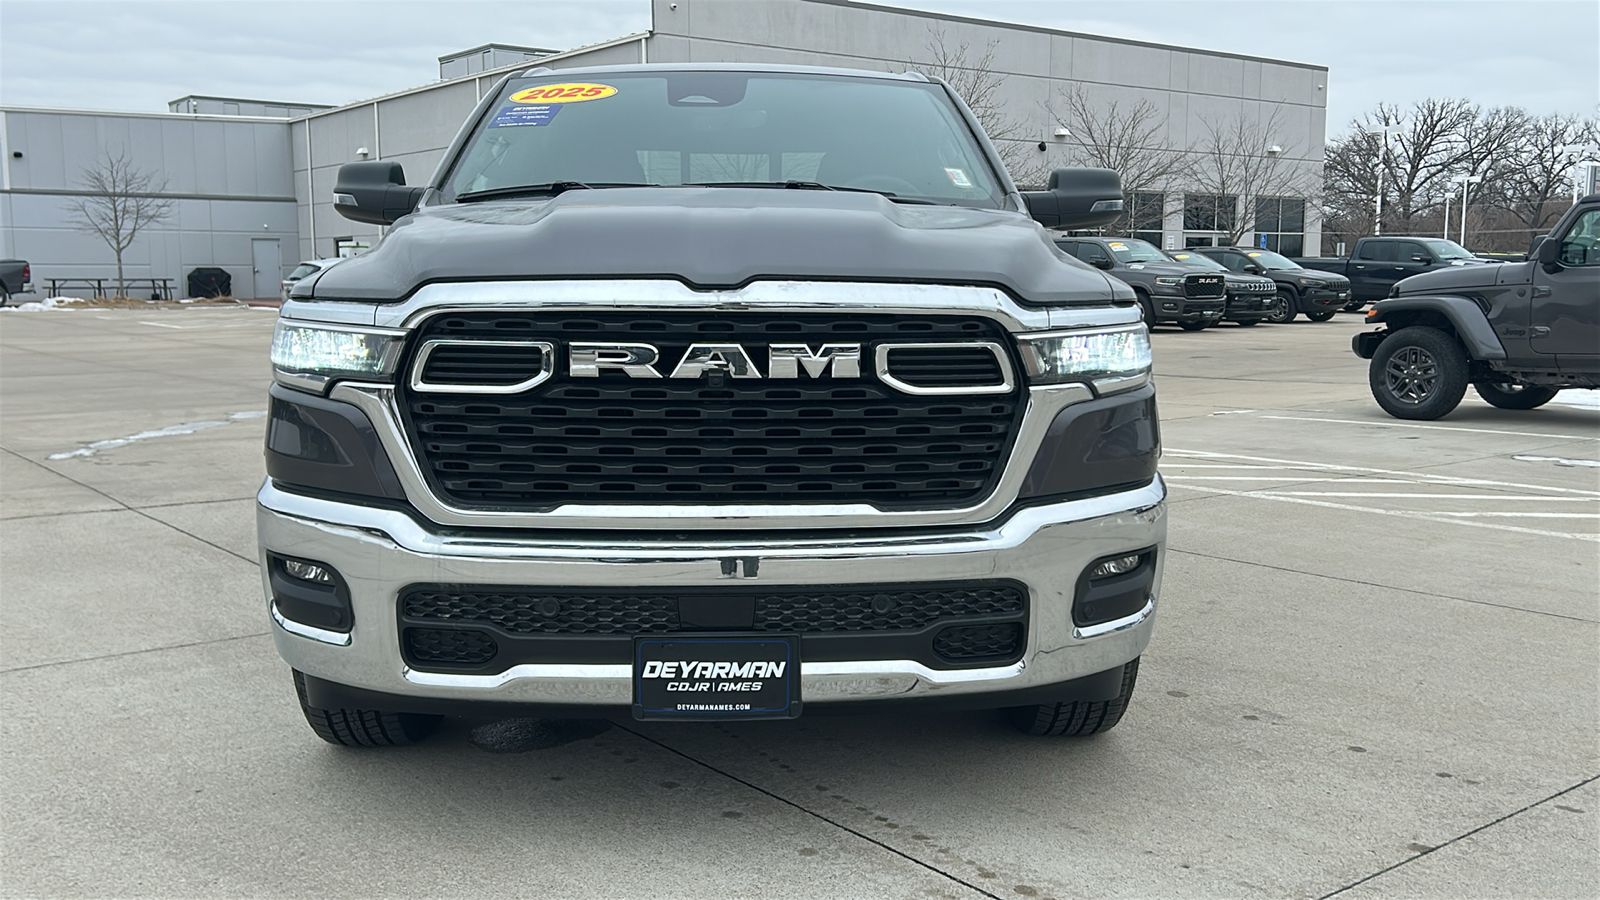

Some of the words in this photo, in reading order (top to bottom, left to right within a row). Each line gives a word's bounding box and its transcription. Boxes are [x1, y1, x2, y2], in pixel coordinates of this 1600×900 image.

[519, 87, 607, 101] 2025
[569, 341, 861, 379] RAM
[642, 660, 787, 679] DEYARMAN
[676, 703, 751, 711] DEYARMANAMES.COM
